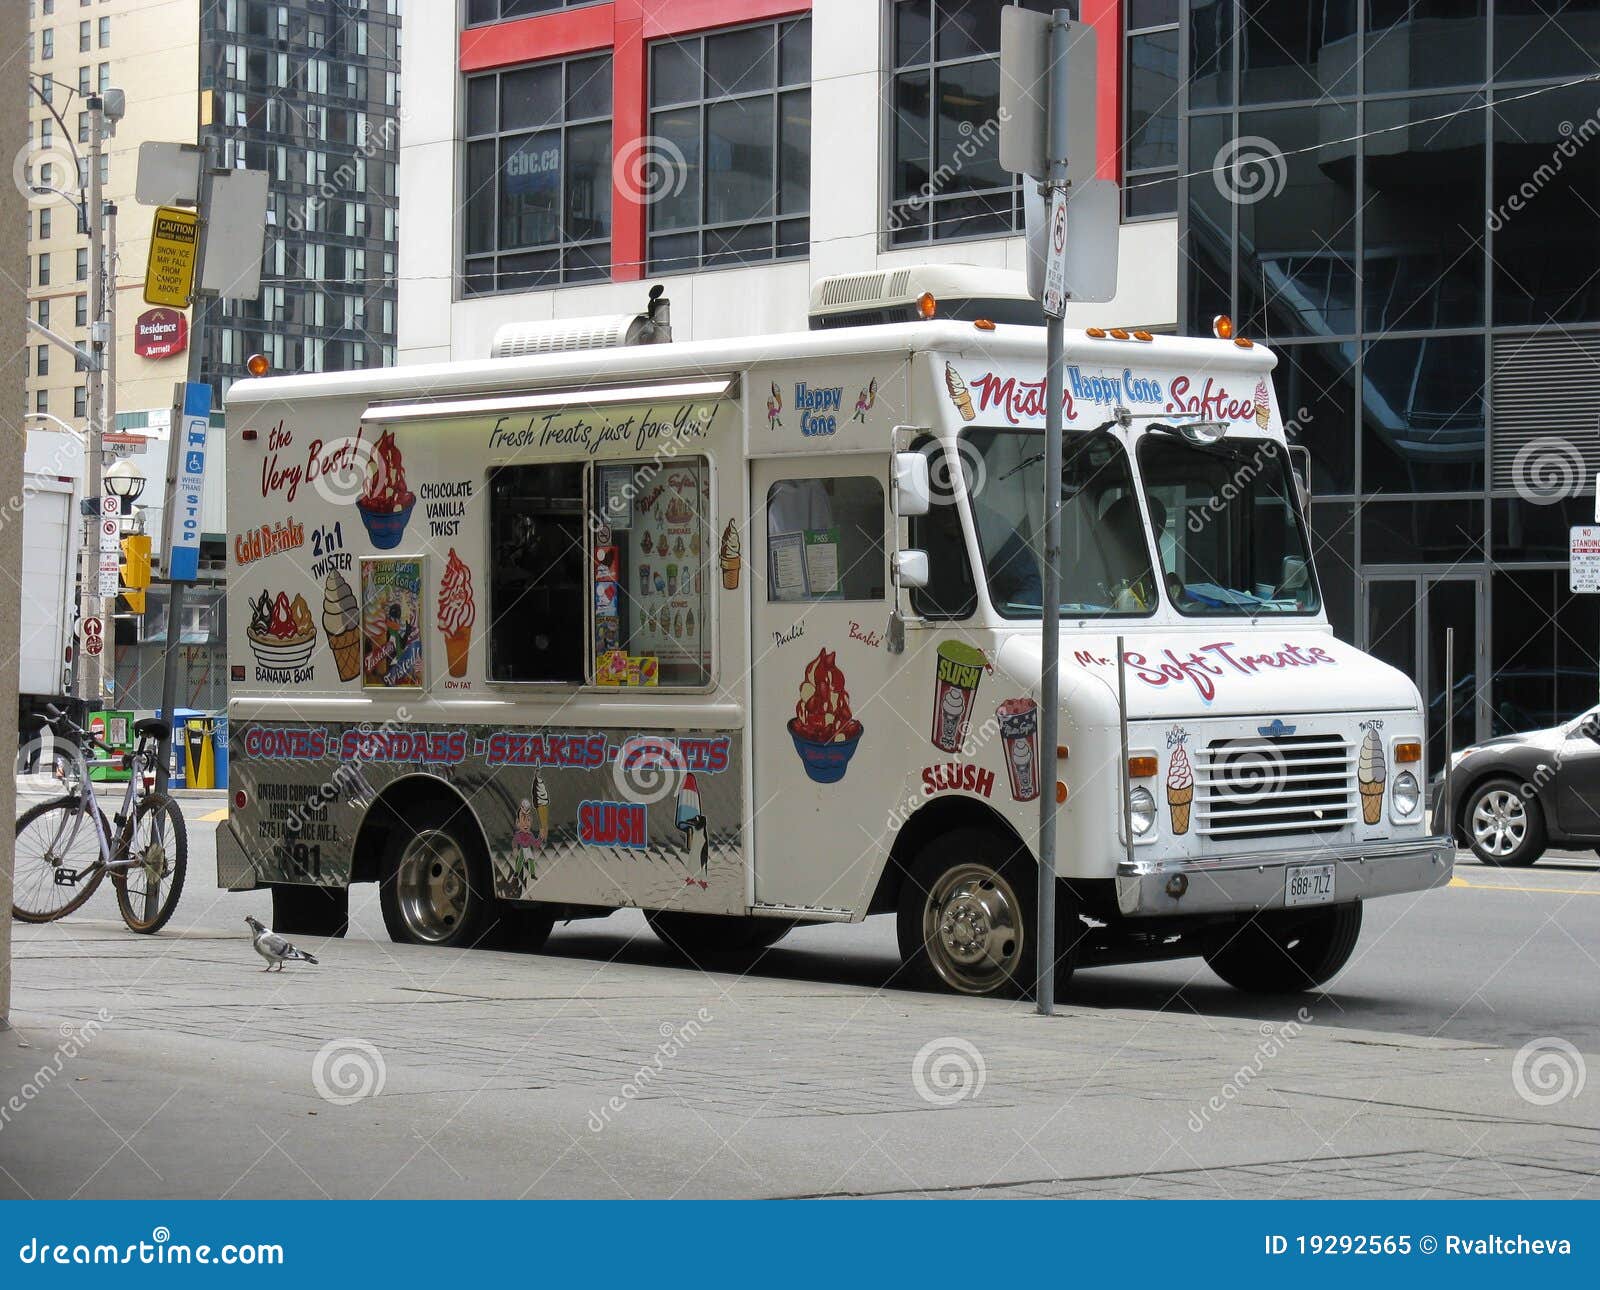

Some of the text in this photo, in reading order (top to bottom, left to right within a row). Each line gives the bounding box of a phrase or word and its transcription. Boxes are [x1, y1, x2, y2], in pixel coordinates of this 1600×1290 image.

[506, 148, 560, 176] cbc.ca
[160, 220, 195, 235] CAUTION
[161, 265, 181, 276] FROM
[171, 258, 187, 268] FALL
[156, 273, 183, 286] CANOPY
[157, 283, 180, 294] ABOVE
[139, 322, 177, 335] Residence
[145, 344, 171, 356] Marriott
[794, 381, 843, 413] Happy
[970, 364, 1257, 425] Mistr Happy Cone Softee
[488, 403, 720, 455] Fresh Treats, just for You!
[800, 409, 837, 437] Cone
[268, 419, 293, 452] the
[111, 442, 138, 453] JOHN ST
[261, 426, 363, 503] Very Best!
[420, 480, 473, 500] CHOCOLATE
[183, 494, 199, 542] STOP
[426, 502, 466, 519] VANILLA
[429, 520, 461, 537] TWIST
[1582, 528, 1592, 538] NO
[234, 516, 305, 566] Cold Drinks
[311, 552, 353, 581] TWISTER
[255, 665, 315, 684] BANANA BOAT
[937, 658, 982, 691] SLUSH
[1122, 647, 1224, 706] Soft
[1199, 641, 1337, 675] Treats
[444, 681, 472, 689] LOW FAT
[1358, 718, 1384, 732] TWISTER
[245, 727, 328, 760] CONES
[339, 728, 467, 765] SUNDAES
[486, 732, 607, 771] SHAKES
[922, 761, 996, 799] SLUSH
[257, 783, 288, 801] ONTARIO
[258, 820, 276, 838] 1275
[577, 800, 648, 850] SLUSH
[1290, 873, 1331, 896] 688 7LZ
